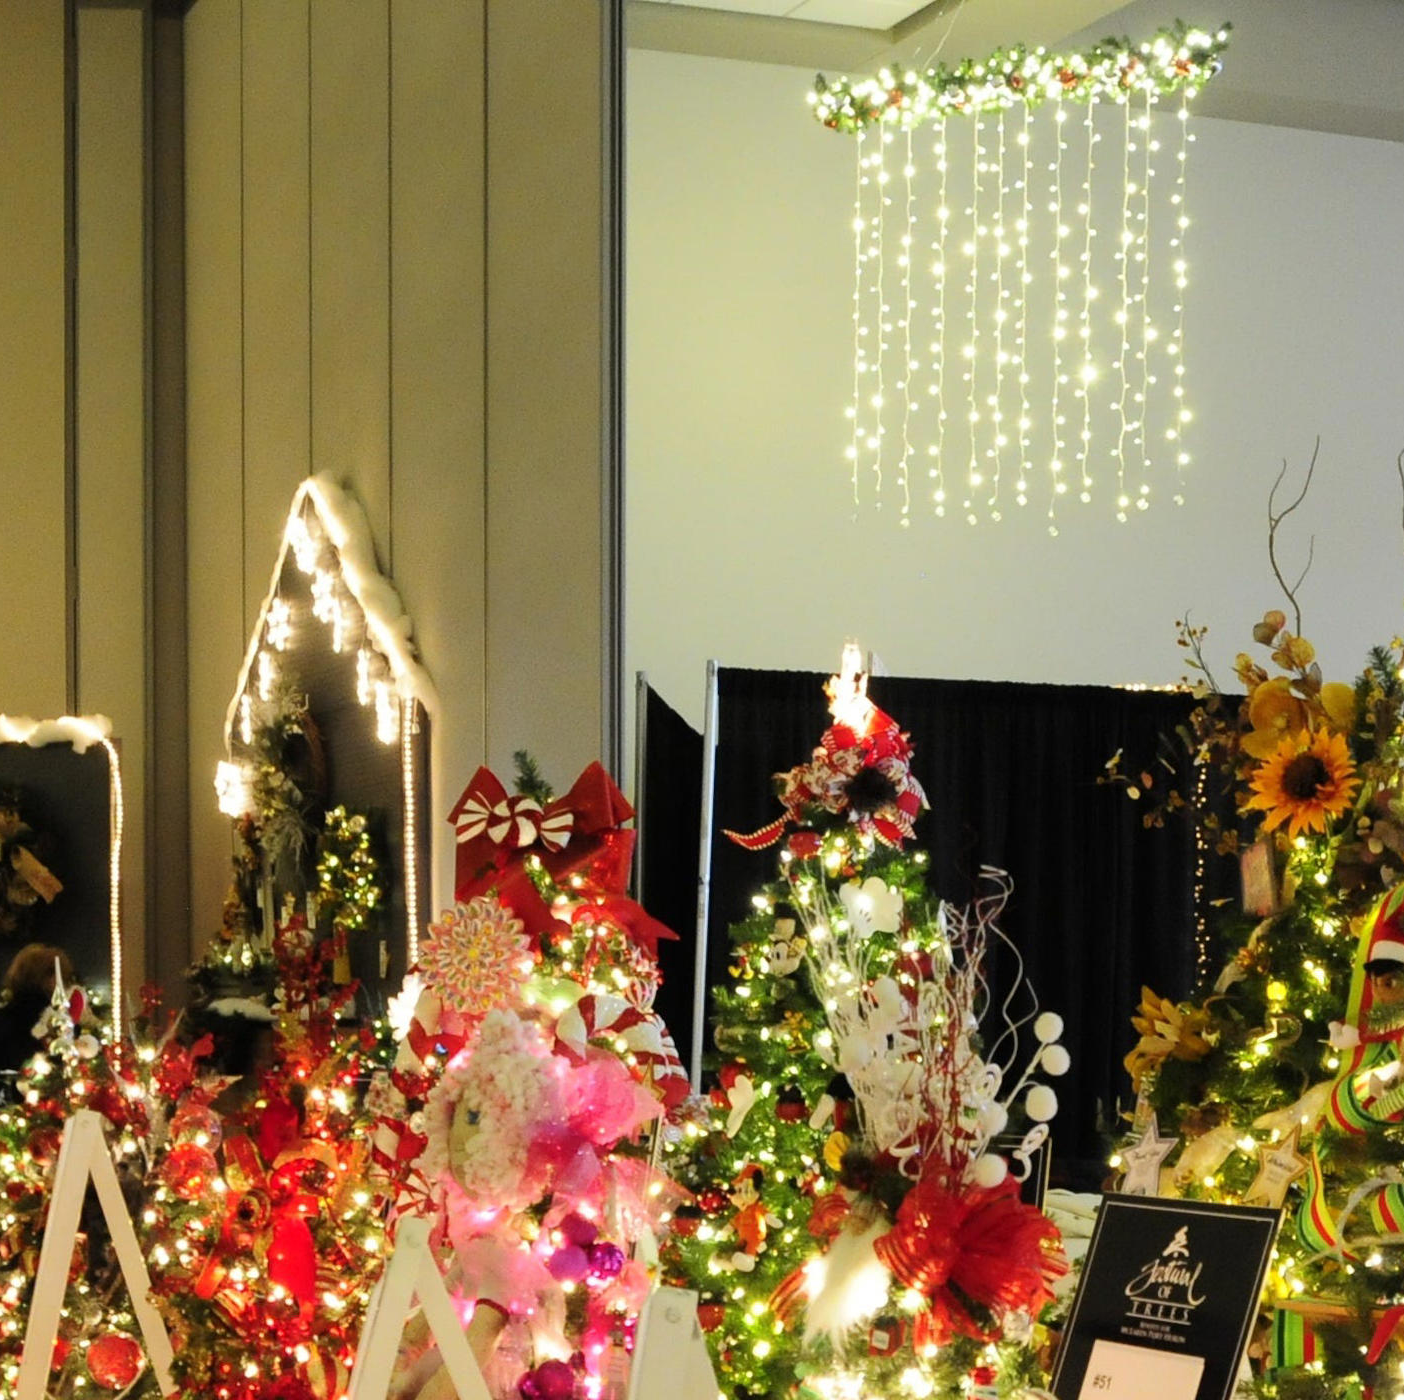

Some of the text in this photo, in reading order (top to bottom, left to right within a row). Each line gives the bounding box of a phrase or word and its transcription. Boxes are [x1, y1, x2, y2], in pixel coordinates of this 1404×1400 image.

[1157, 1285, 1172, 1298] OF
[1132, 1301, 1189, 1321] TREES
[1093, 1374, 1112, 1391] #51
